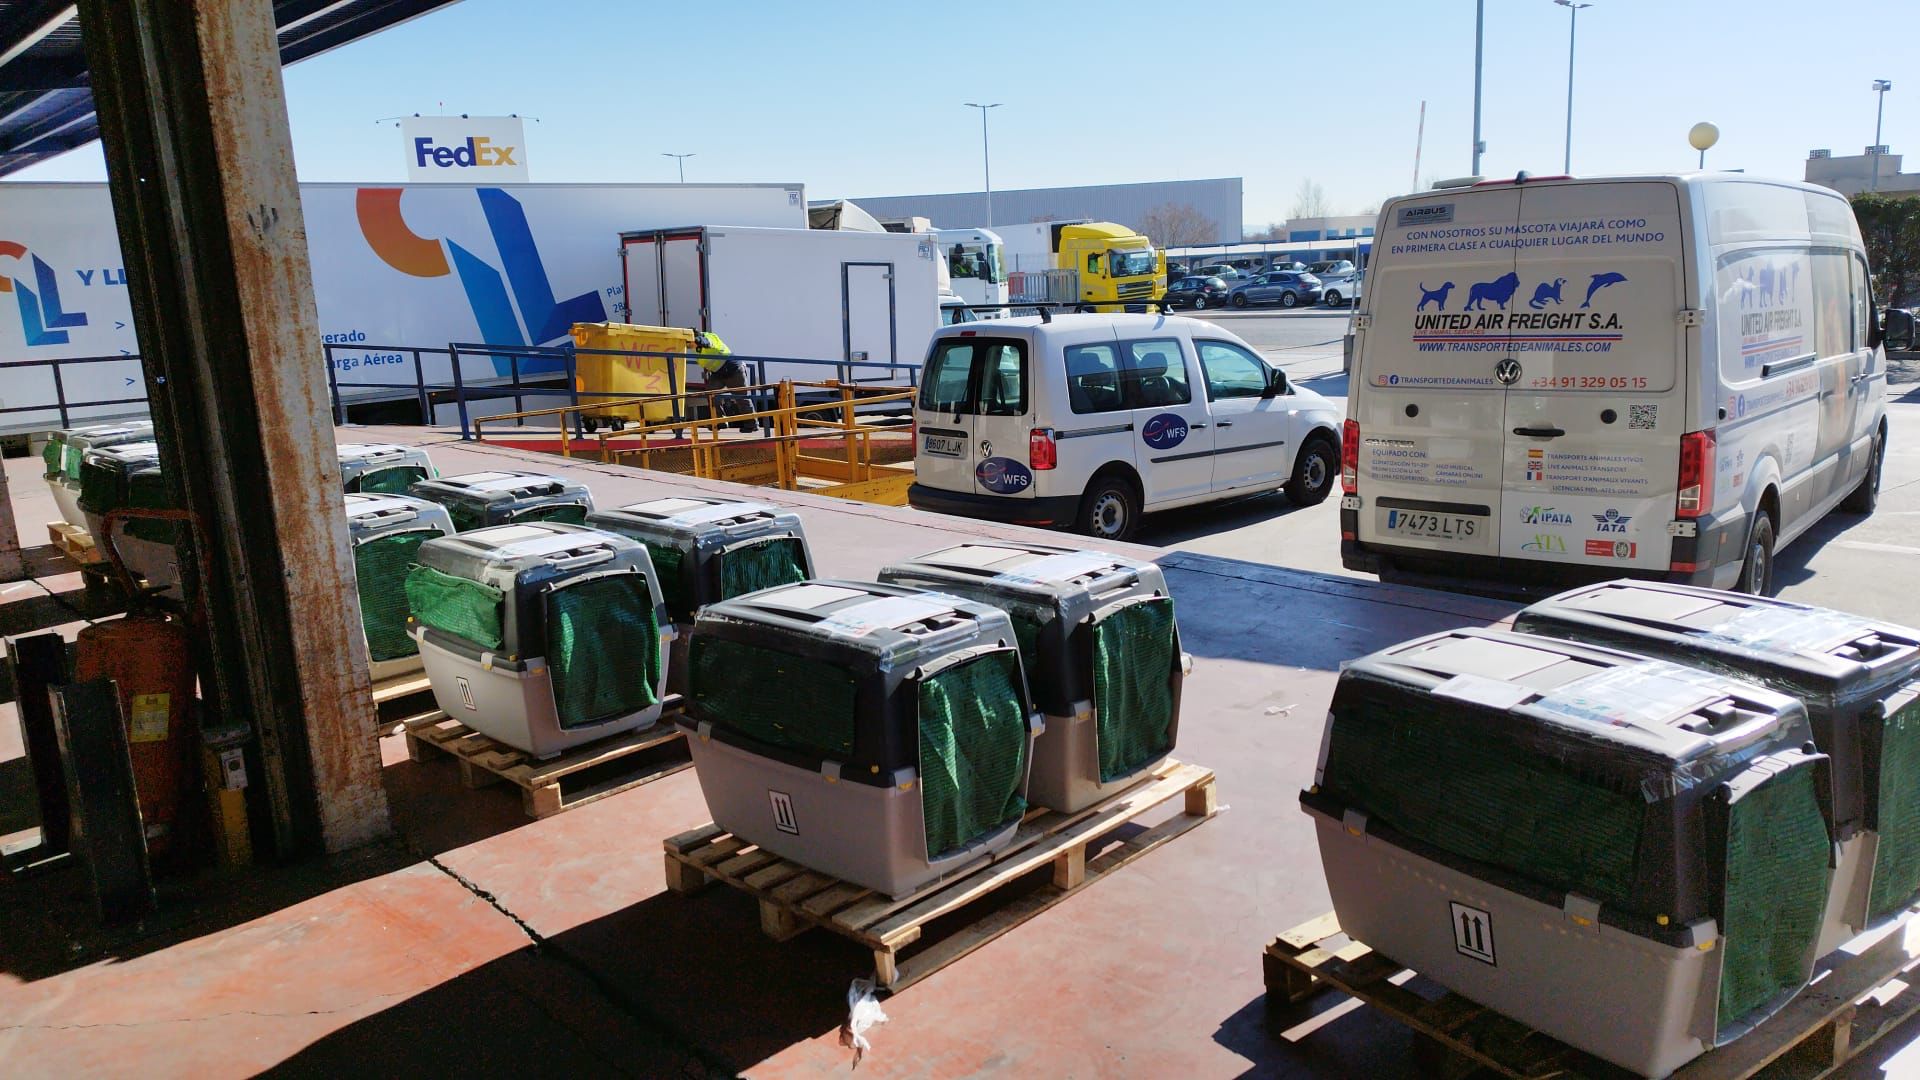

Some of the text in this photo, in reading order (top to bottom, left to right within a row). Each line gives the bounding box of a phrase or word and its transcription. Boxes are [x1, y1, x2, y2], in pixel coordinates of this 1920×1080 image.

[414, 136, 517, 168] FedEx
[1406, 206, 1447, 217] AIRBUS
[1407, 231, 1429, 241] CON
[1430, 226, 1486, 239] NOSOTROS
[1489, 226, 1503, 236] SU
[1505, 223, 1557, 235] MASCOTA
[1607, 218, 1646, 229] COMO
[1391, 231, 1665, 255] EN PRIMERA CLASE A CUALQUIER LUGAR DEL MUNDO
[76, 269, 94, 286] Y
[1415, 312, 1624, 330] UNITED AIR FREIGHT S.A.
[321, 329, 366, 344] erado
[1419, 342, 1612, 352] WWW.TRANSPORTEDEANIMALES.COM
[326, 353, 403, 371] rga Aérea
[1400, 376, 1494, 385] TRANSPORTEDEANIMALES
[1531, 377, 1648, 388] +34 91 329 05 15
[1166, 427, 1186, 439] WFS
[928, 439, 962, 453] 8607 LJK
[1372, 449, 1408, 457] EQUIPADO
[1003, 474, 1028, 486] WFS
[1398, 513, 1438, 532] 7473
[1443, 517, 1475, 536] LTS
[1541, 512, 1573, 524] IPATA
[1596, 523, 1627, 533] IATA
